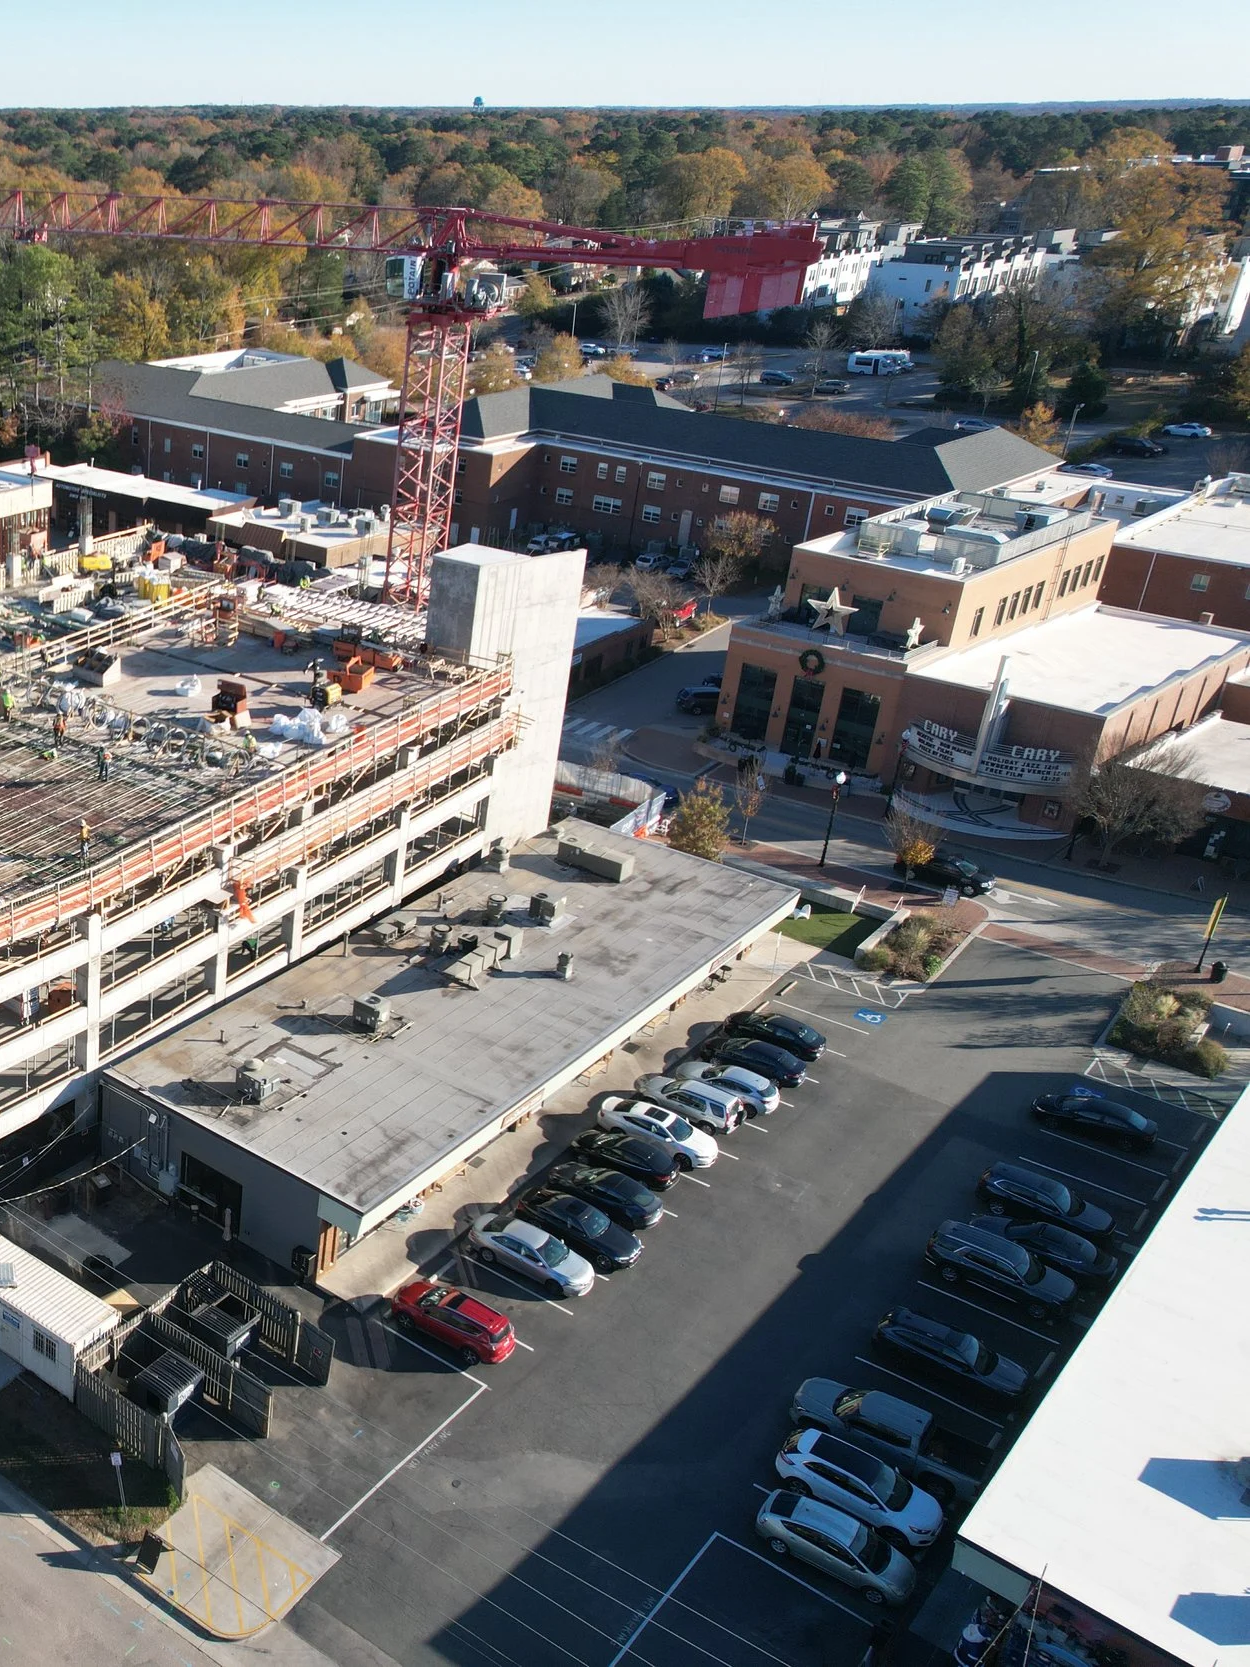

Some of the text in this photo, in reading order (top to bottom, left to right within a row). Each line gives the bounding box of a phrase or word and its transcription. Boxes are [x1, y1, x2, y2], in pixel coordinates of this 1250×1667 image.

[407, 260, 416, 295] POTAIN
[923, 719, 958, 742] CARY
[1011, 745, 1061, 762] CARY
[981, 760, 1019, 771] NEWBERRY
[987, 756, 1019, 766] HOLIDAY
[985, 766, 1002, 775] FREE
[1005, 770, 1023, 778] FILM
